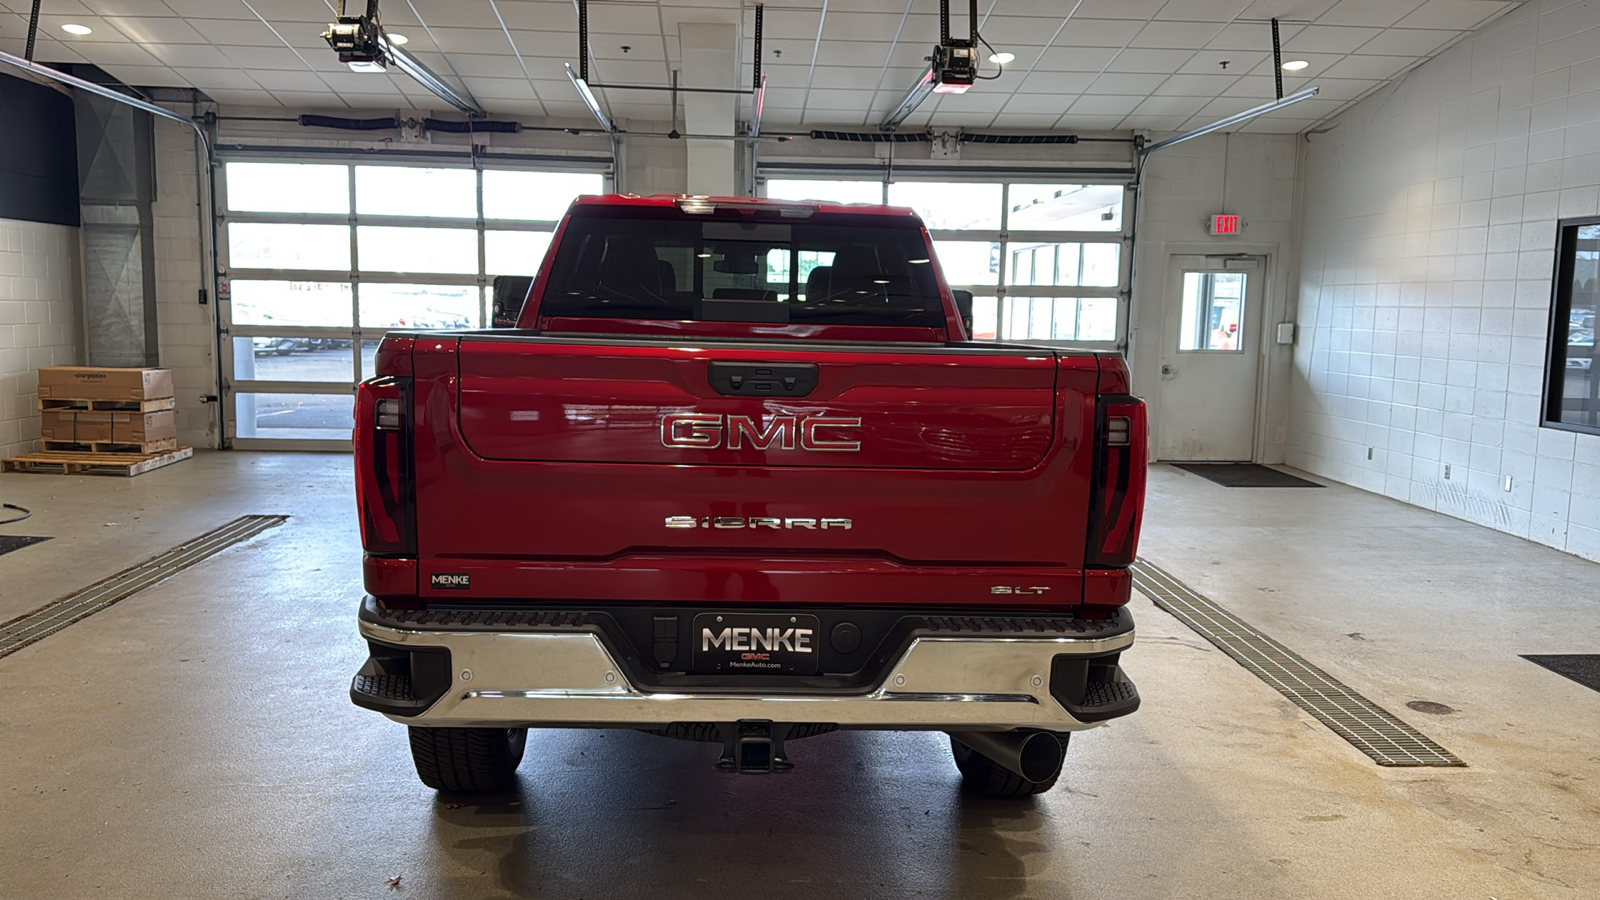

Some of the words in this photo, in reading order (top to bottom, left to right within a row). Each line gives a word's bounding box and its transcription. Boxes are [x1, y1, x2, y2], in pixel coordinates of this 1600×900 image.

[1216, 215, 1238, 233] EXIT
[660, 413, 862, 451] GMC
[664, 516, 853, 530] SIERRA
[431, 575, 469, 584] MENKE
[990, 586, 1051, 595] SLT
[702, 628, 813, 653] MENKE
